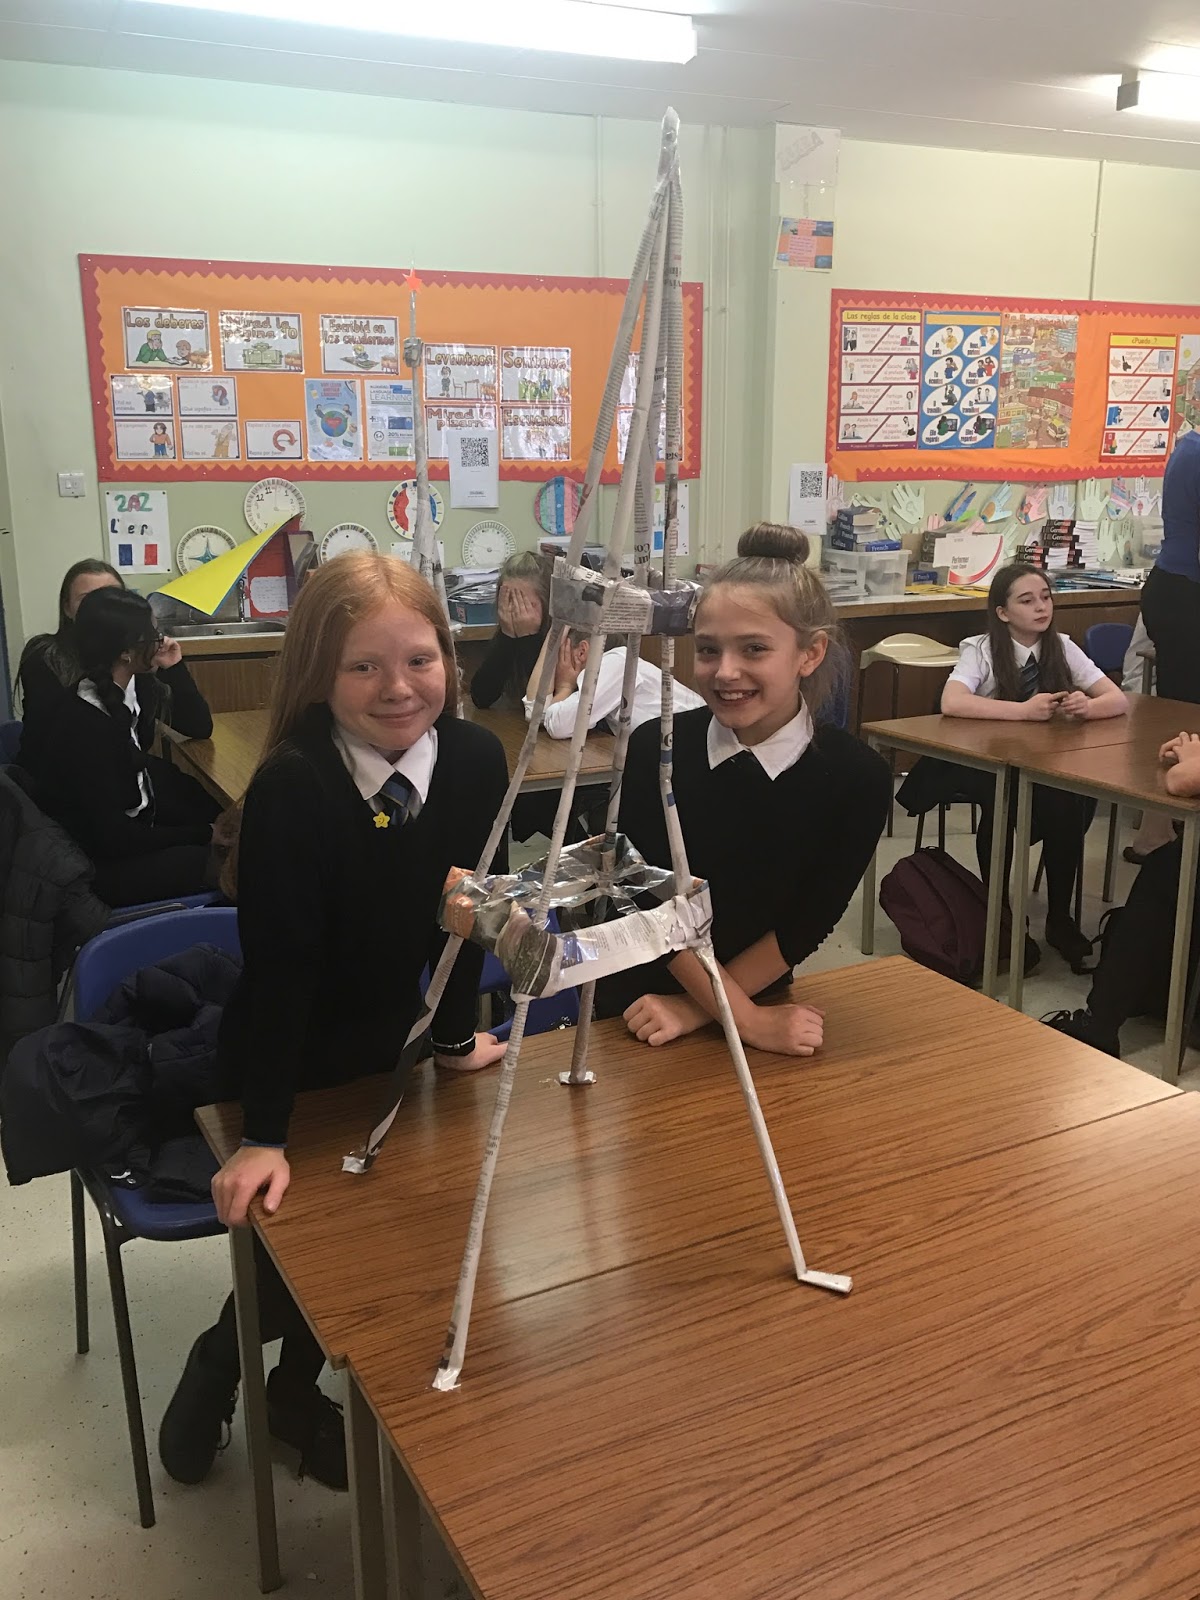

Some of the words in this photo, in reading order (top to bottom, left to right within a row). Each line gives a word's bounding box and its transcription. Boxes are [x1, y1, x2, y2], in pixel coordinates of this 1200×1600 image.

[126, 311, 150, 328] Los
[154, 313, 205, 330] deberes
[846, 312, 858, 320] Las
[860, 313, 880, 321] reglas
[329, 319, 371, 334] Escribid
[373, 324, 387, 334] en
[343, 331, 395, 346] cuadernos
[426, 347, 494, 367] Levantaos
[503, 350, 567, 369] Sentaos
[428, 408, 474, 420] Mirad
[503, 409, 566, 427] Escuchad
[114, 492, 153, 512] 2A2
